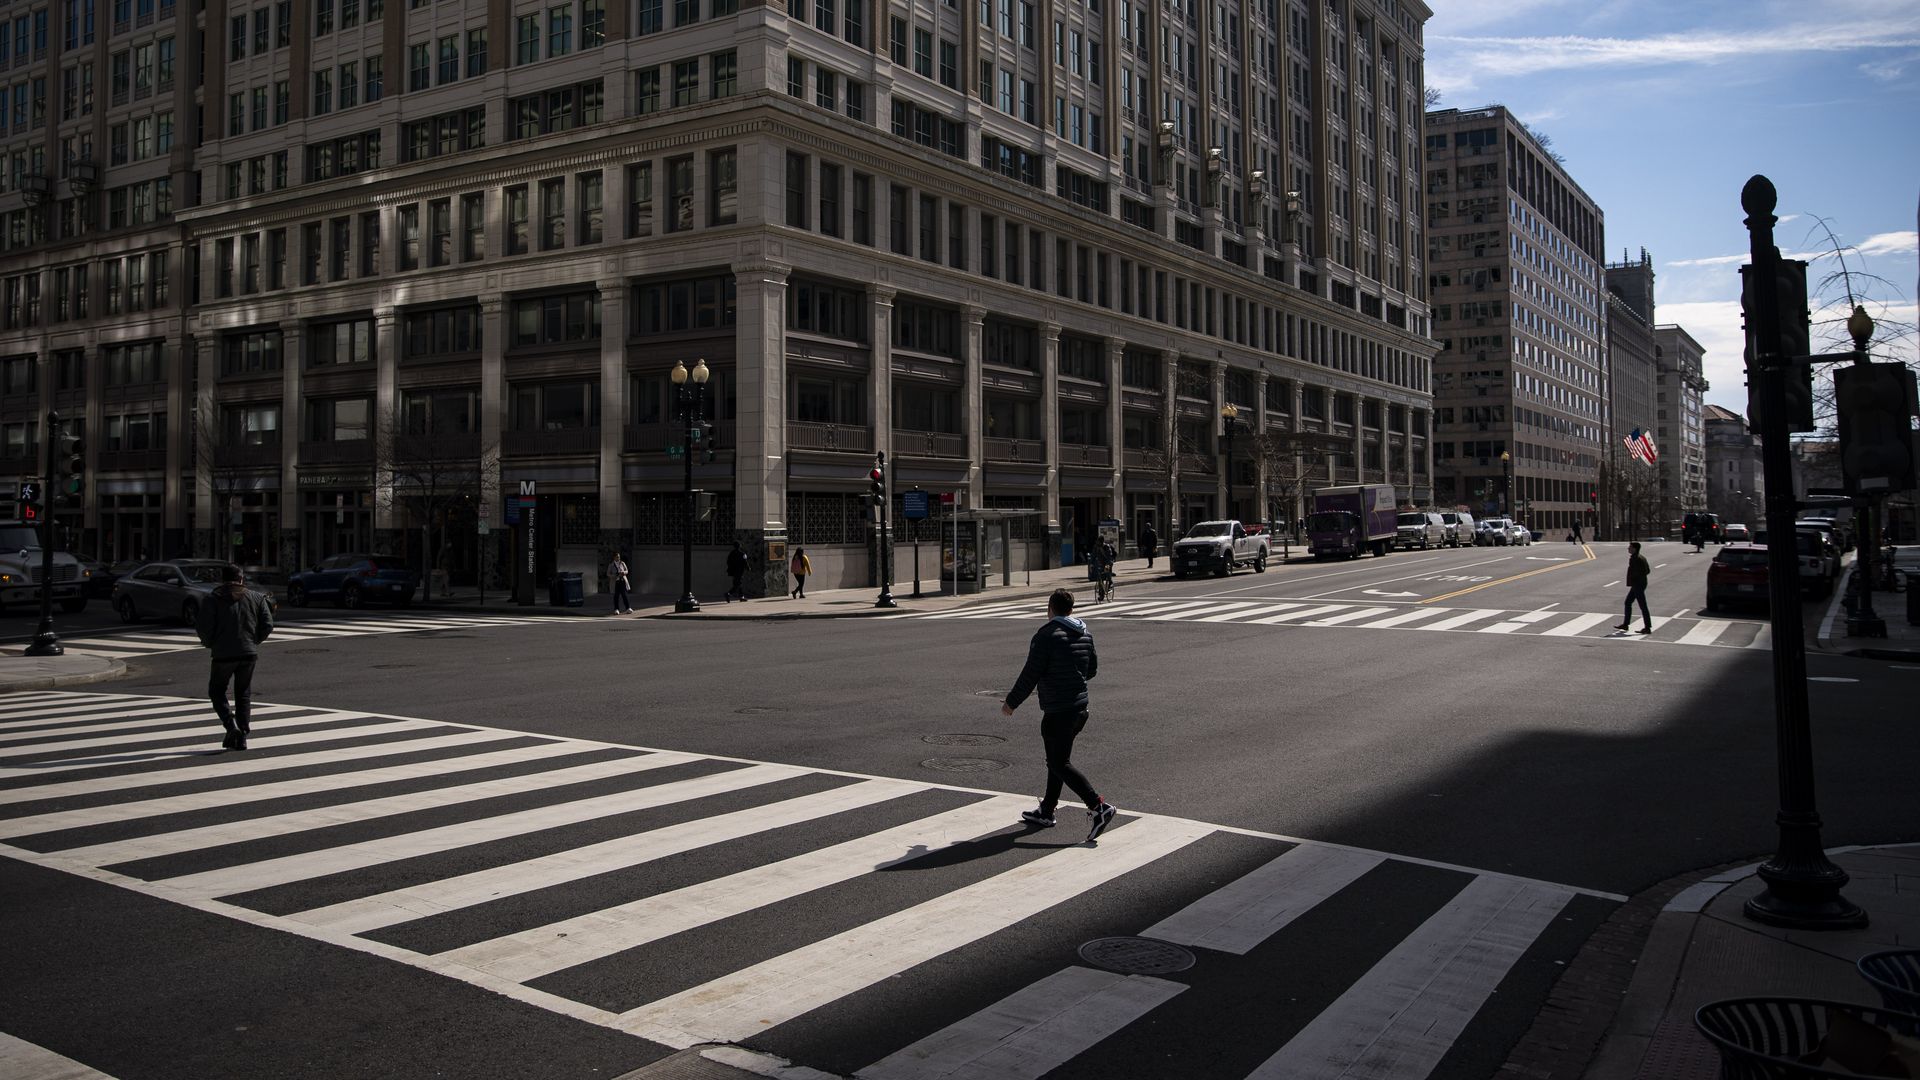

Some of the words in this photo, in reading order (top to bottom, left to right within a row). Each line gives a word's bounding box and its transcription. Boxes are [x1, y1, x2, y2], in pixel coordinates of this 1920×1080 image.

[299, 476, 326, 485] PANERA
[520, 480, 536, 496] M
[528, 508, 536, 527] Metro
